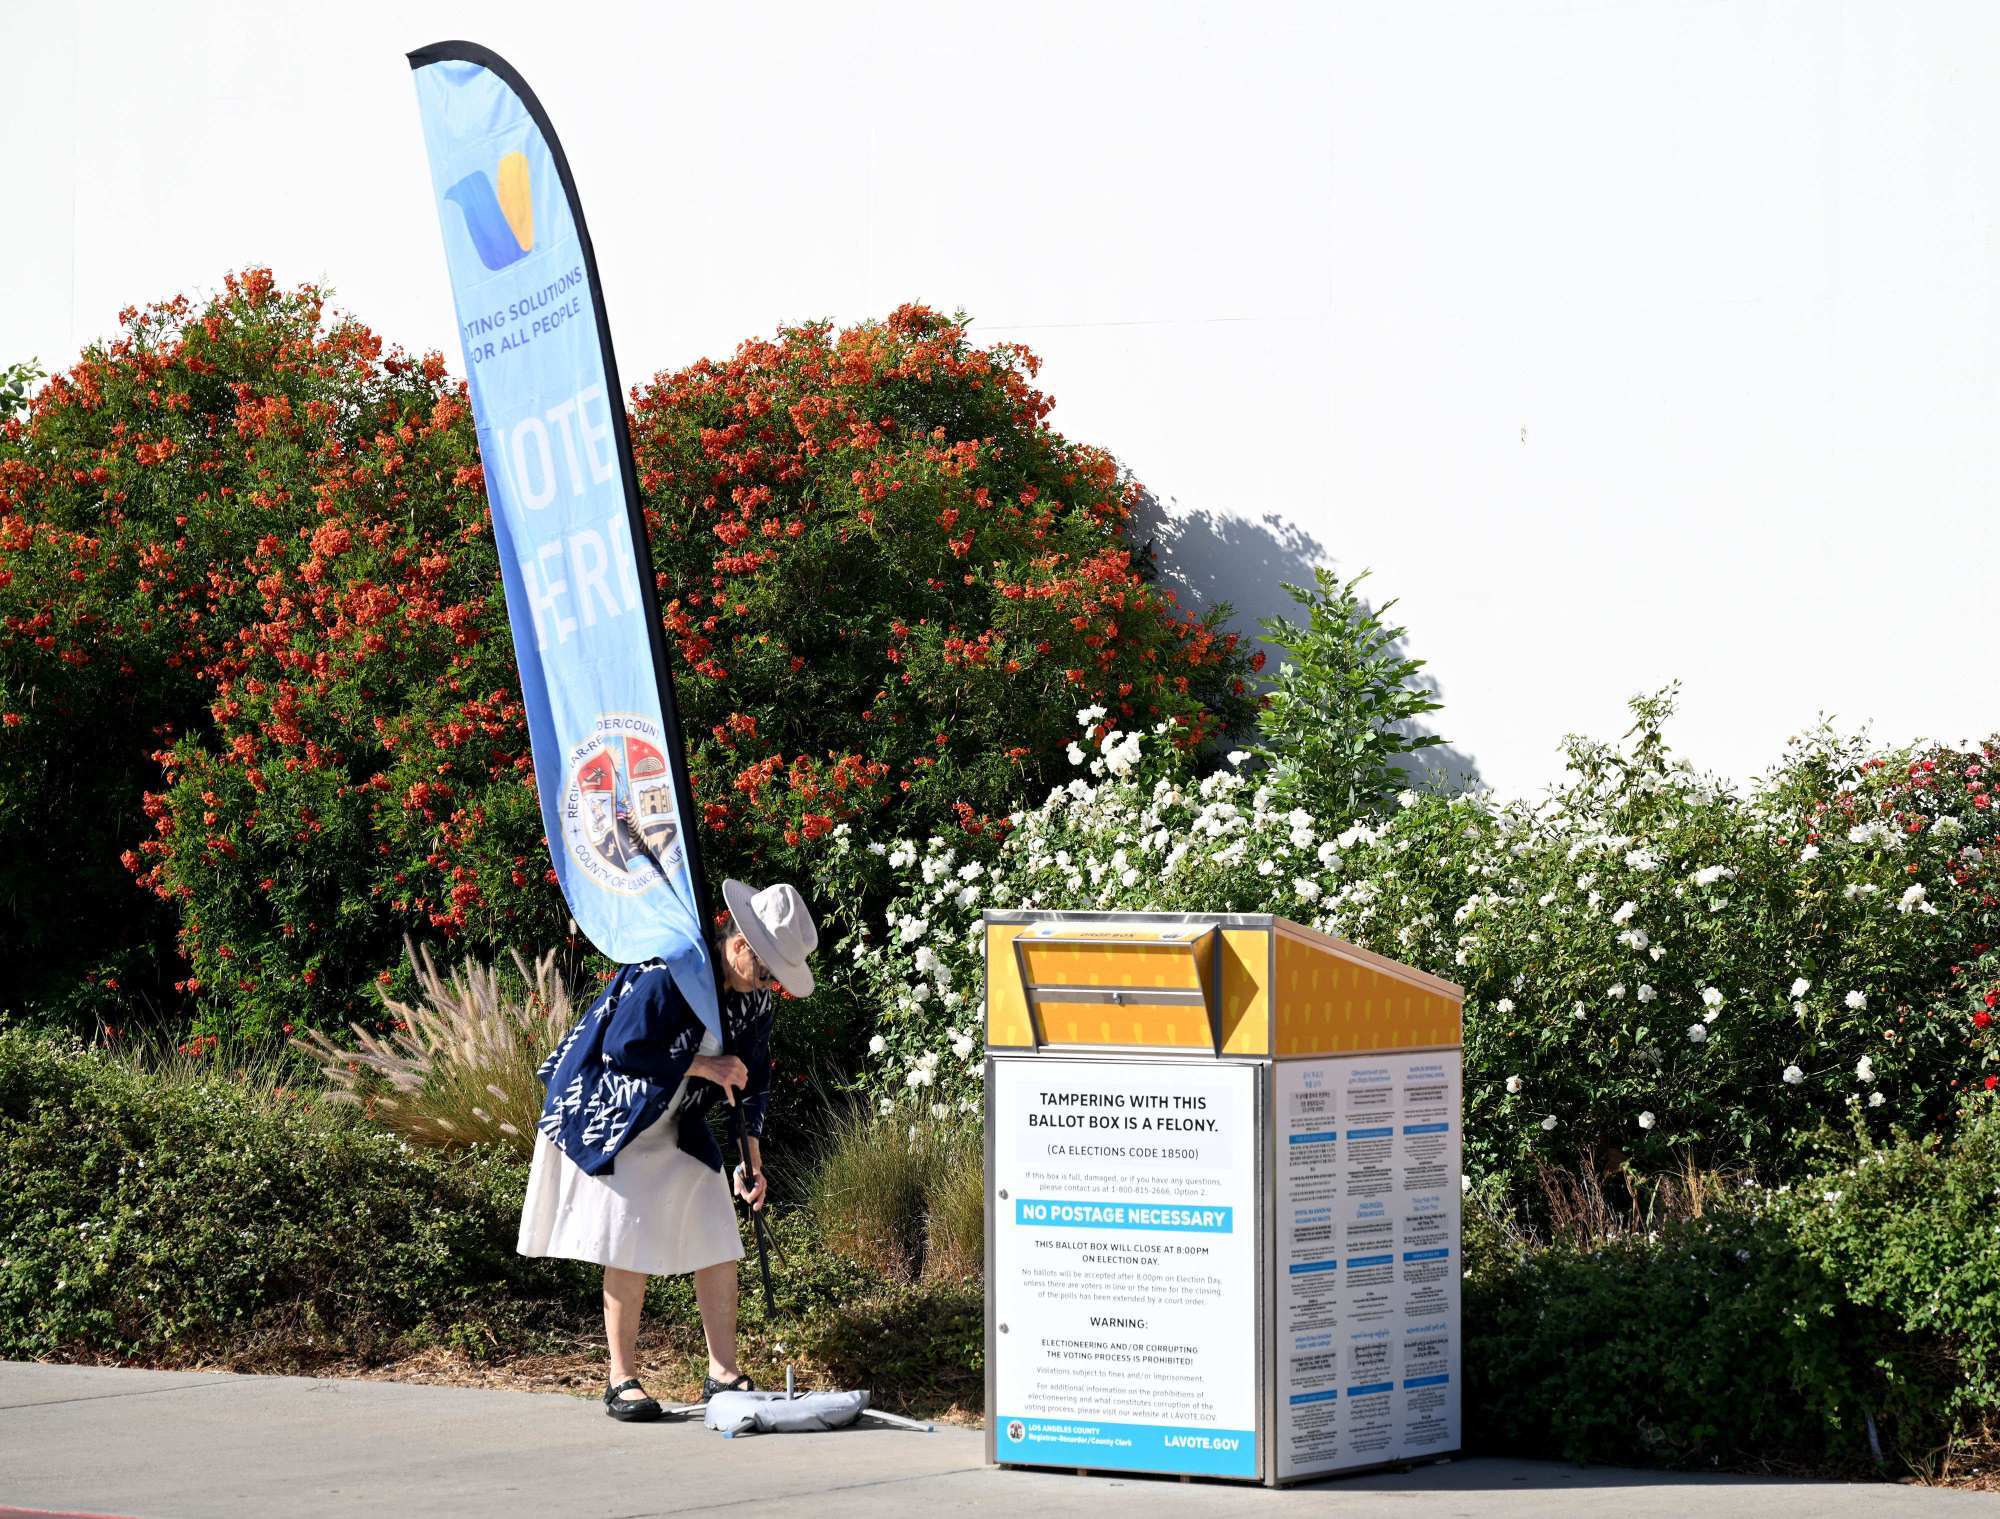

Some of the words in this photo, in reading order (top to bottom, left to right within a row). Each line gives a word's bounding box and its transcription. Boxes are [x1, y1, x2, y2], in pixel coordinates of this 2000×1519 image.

[464, 311, 505, 343] TING
[508, 266, 583, 321] SOLUTIONS
[471, 342, 496, 365] OR
[500, 328, 531, 354] ALL
[532, 297, 581, 338] PEOPLE
[498, 384, 614, 521] OTE
[575, 844, 613, 881] COUNTY
[1039, 1092, 1125, 1107] TAMPERING
[1129, 1094, 1168, 1109] WITH
[1172, 1095, 1206, 1109] THIS
[1028, 1113, 1085, 1128] BALLOT
[1089, 1115, 1120, 1129] BOX
[1124, 1115, 1137, 1130] IS
[1141, 1116, 1152, 1130] A
[1156, 1116, 1218, 1132] FELONY.
[1047, 1143, 1065, 1156] (CA
[1068, 1144, 1125, 1158] ELECTIONS
[1128, 1145, 1160, 1159] CODE
[1160, 1146, 1199, 1160] 18500)
[1025, 1171, 1031, 1179] If
[1031, 1172, 1045, 1180] this
[1046, 1172, 1059, 1180] box
[1061, 1172, 1067, 1181] is
[1129, 1175, 1134, 1183] if
[1136, 1177, 1149, 1185] you
[1151, 1175, 1169, 1184] have
[1170, 1178, 1183, 1186] any
[1039, 1183, 1062, 1193] please
[1063, 1184, 1090, 1192] contact
[1173, 1187, 1198, 1197] Option
[1022, 1204, 1046, 1220] NO
[1050, 1205, 1124, 1223] POSTAGE
[1128, 1207, 1225, 1227] NECESSARY
[1035, 1239, 1053, 1249] THIS
[1055, 1240, 1088, 1250] BALLOT
[1089, 1242, 1108, 1251] BOX
[1110, 1242, 1131, 1252] WILL
[1133, 1243, 1161, 1253] CLOSE
[1163, 1244, 1173, 1254] AT
[1176, 1245, 1208, 1255] 8:00PM
[1082, 1254, 1095, 1263] ON
[1097, 1255, 1138, 1265] ELECTION
[1140, 1256, 1159, 1266] DAY.
[1021, 1268, 1031, 1276] No
[1033, 1268, 1057, 1277] ballots
[1058, 1269, 1071, 1277] will
[1073, 1270, 1082, 1278] be
[1083, 1270, 1115, 1281] accepted
[1117, 1272, 1134, 1280] after
[1176, 1274, 1205, 1283] Election
[1023, 1279, 1045, 1287] unless
[1047, 1280, 1065, 1288] there
[1080, 1281, 1102, 1290] voters
[1104, 1282, 1110, 1290] in
[1137, 1284, 1148, 1292] the
[1151, 1284, 1167, 1293] time
[1168, 1285, 1178, 1293] for
[1181, 1286, 1193, 1294] the
[1195, 1286, 1221, 1297] closing
[1037, 1290, 1045, 1298] of
[1047, 1291, 1058, 1299] the
[1060, 1291, 1077, 1302] polls
[1079, 1292, 1091, 1300] has
[1093, 1293, 1110, 1301] been
[1112, 1293, 1145, 1303] extended
[1147, 1295, 1155, 1305] by
[1163, 1296, 1182, 1304] court
[1089, 1316, 1148, 1329] WARNING:
[1041, 1338, 1108, 1350] ELECTIONEERING
[1110, 1341, 1143, 1352] AND/OR
[1145, 1343, 1198, 1354] CORRUPTING
[1046, 1350, 1061, 1359] THE
[1063, 1350, 1092, 1360] VOTING
[1094, 1352, 1131, 1362] PROCESS
[1132, 1354, 1140, 1363] IS
[1035, 1366, 1070, 1375] Violations
[1072, 1368, 1097, 1379] subject
[1098, 1369, 1106, 1377] to
[1108, 1370, 1124, 1378] fines
[1036, 1381, 1047, 1390] For
[1049, 1382, 1084, 1392] additional
[1086, 1384, 1126, 1394] information
[1139, 1387, 1150, 1395] the
[1152, 1388, 1194, 1400] prohibitions
[1196, 1390, 1204, 1398] of
[1027, 1392, 1077, 1404] electioneering
[1079, 1395, 1092, 1403] and
[1093, 1396, 1110, 1404] what
[1112, 1397, 1151, 1407] constitutes
[1153, 1399, 1190, 1411] corruption
[1192, 1401, 1199, 1409] of
[1200, 1402, 1213, 1410] the
[1024, 1402, 1045, 1413] voting
[1077, 1406, 1100, 1416] please
[1102, 1407, 1116, 1415] visit
[1131, 1409, 1159, 1418] website
[1161, 1410, 1168, 1418] at
[1028, 1422, 1041, 1432] LOS
[1042, 1423, 1071, 1434] ANGELES
[1072, 1425, 1099, 1436] COUNTY
[1163, 1434, 1239, 1451] LAVOTE.GOV
